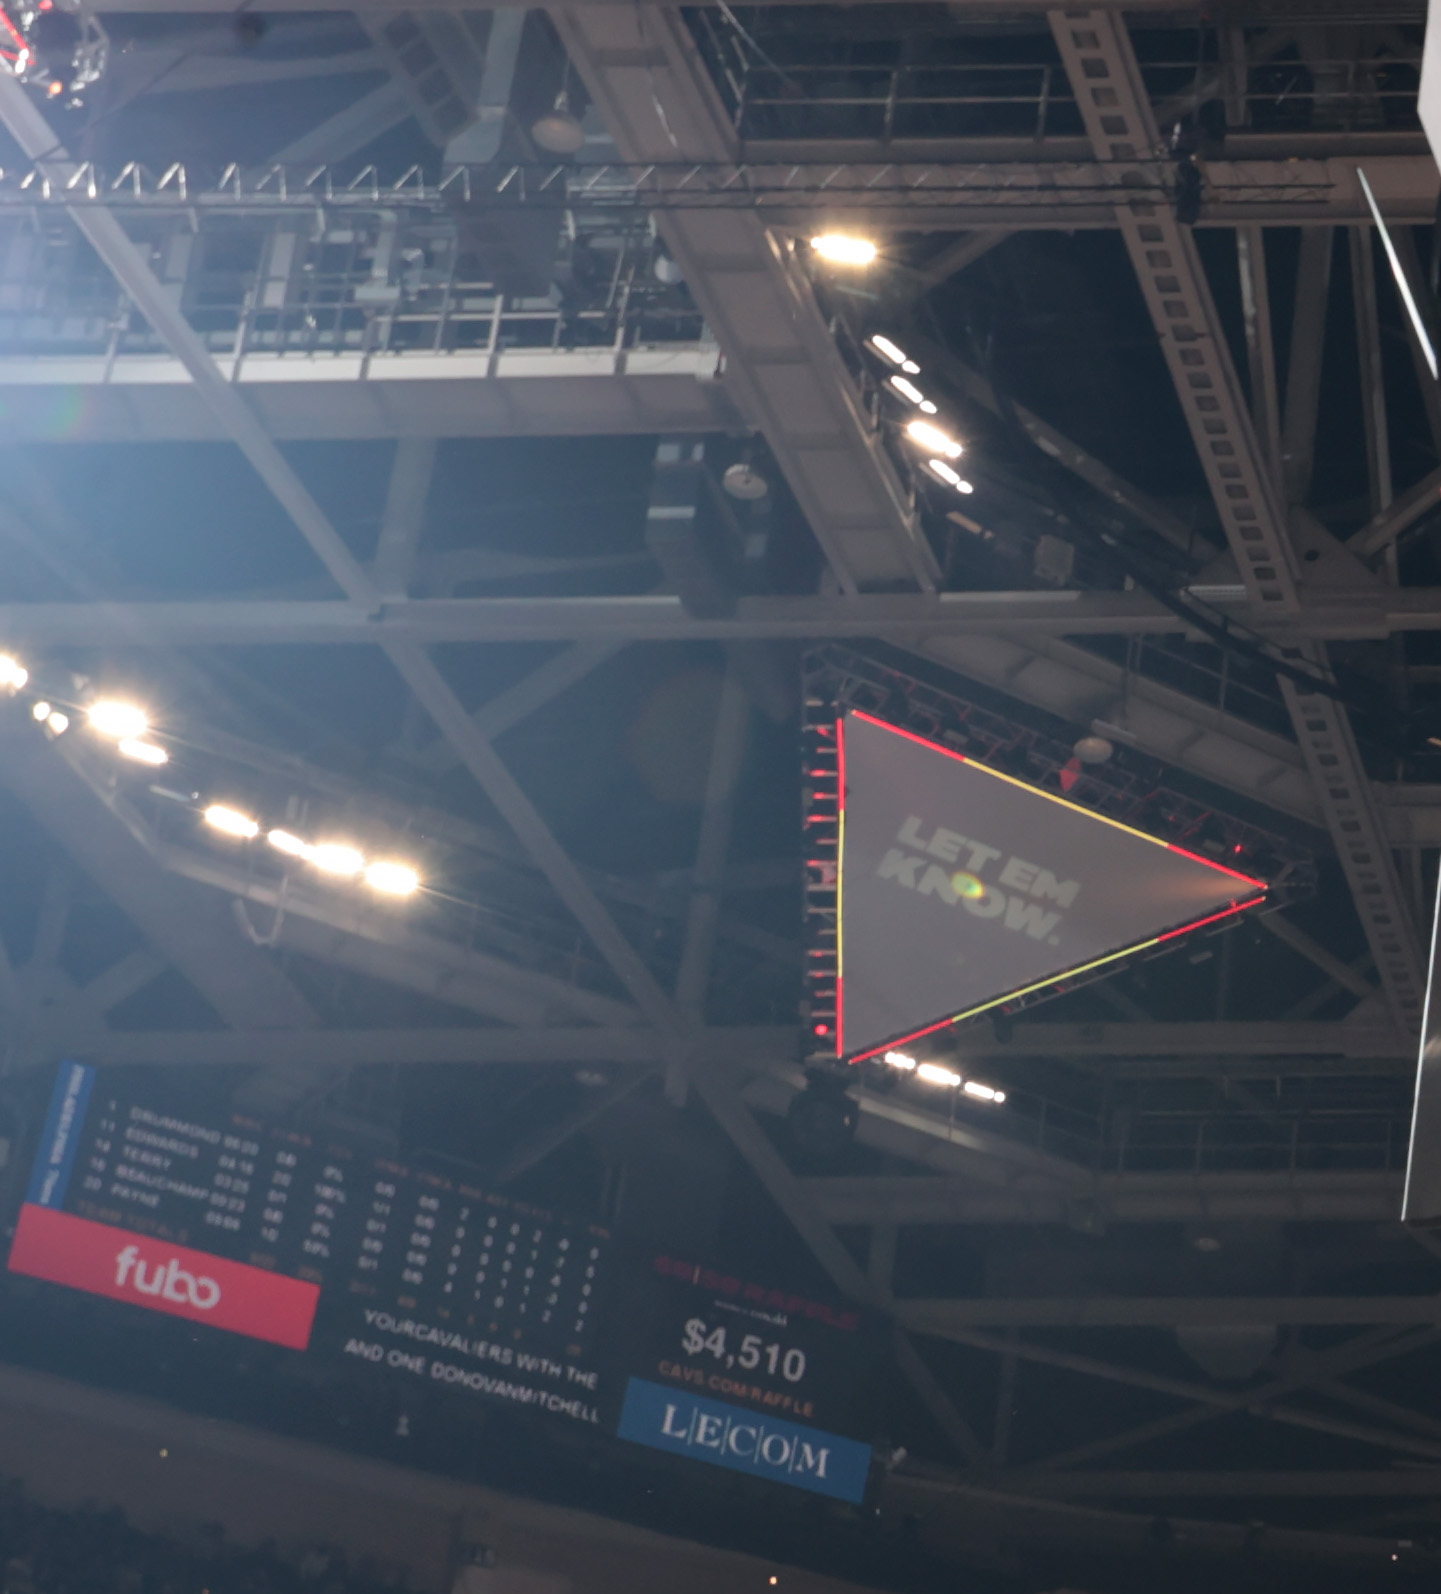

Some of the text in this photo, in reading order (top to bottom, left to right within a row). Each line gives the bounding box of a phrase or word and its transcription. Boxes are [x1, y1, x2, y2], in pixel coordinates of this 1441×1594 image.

[897, 815, 1081, 909] LET EM
[116, 1245, 221, 1310] fubo
[344, 1338, 600, 1424] AND ONE DONOVANMITCHELL
[516, 1353, 562, 1377] WITH
[567, 1366, 600, 1391] THE
[682, 1318, 807, 1383] $4,510
